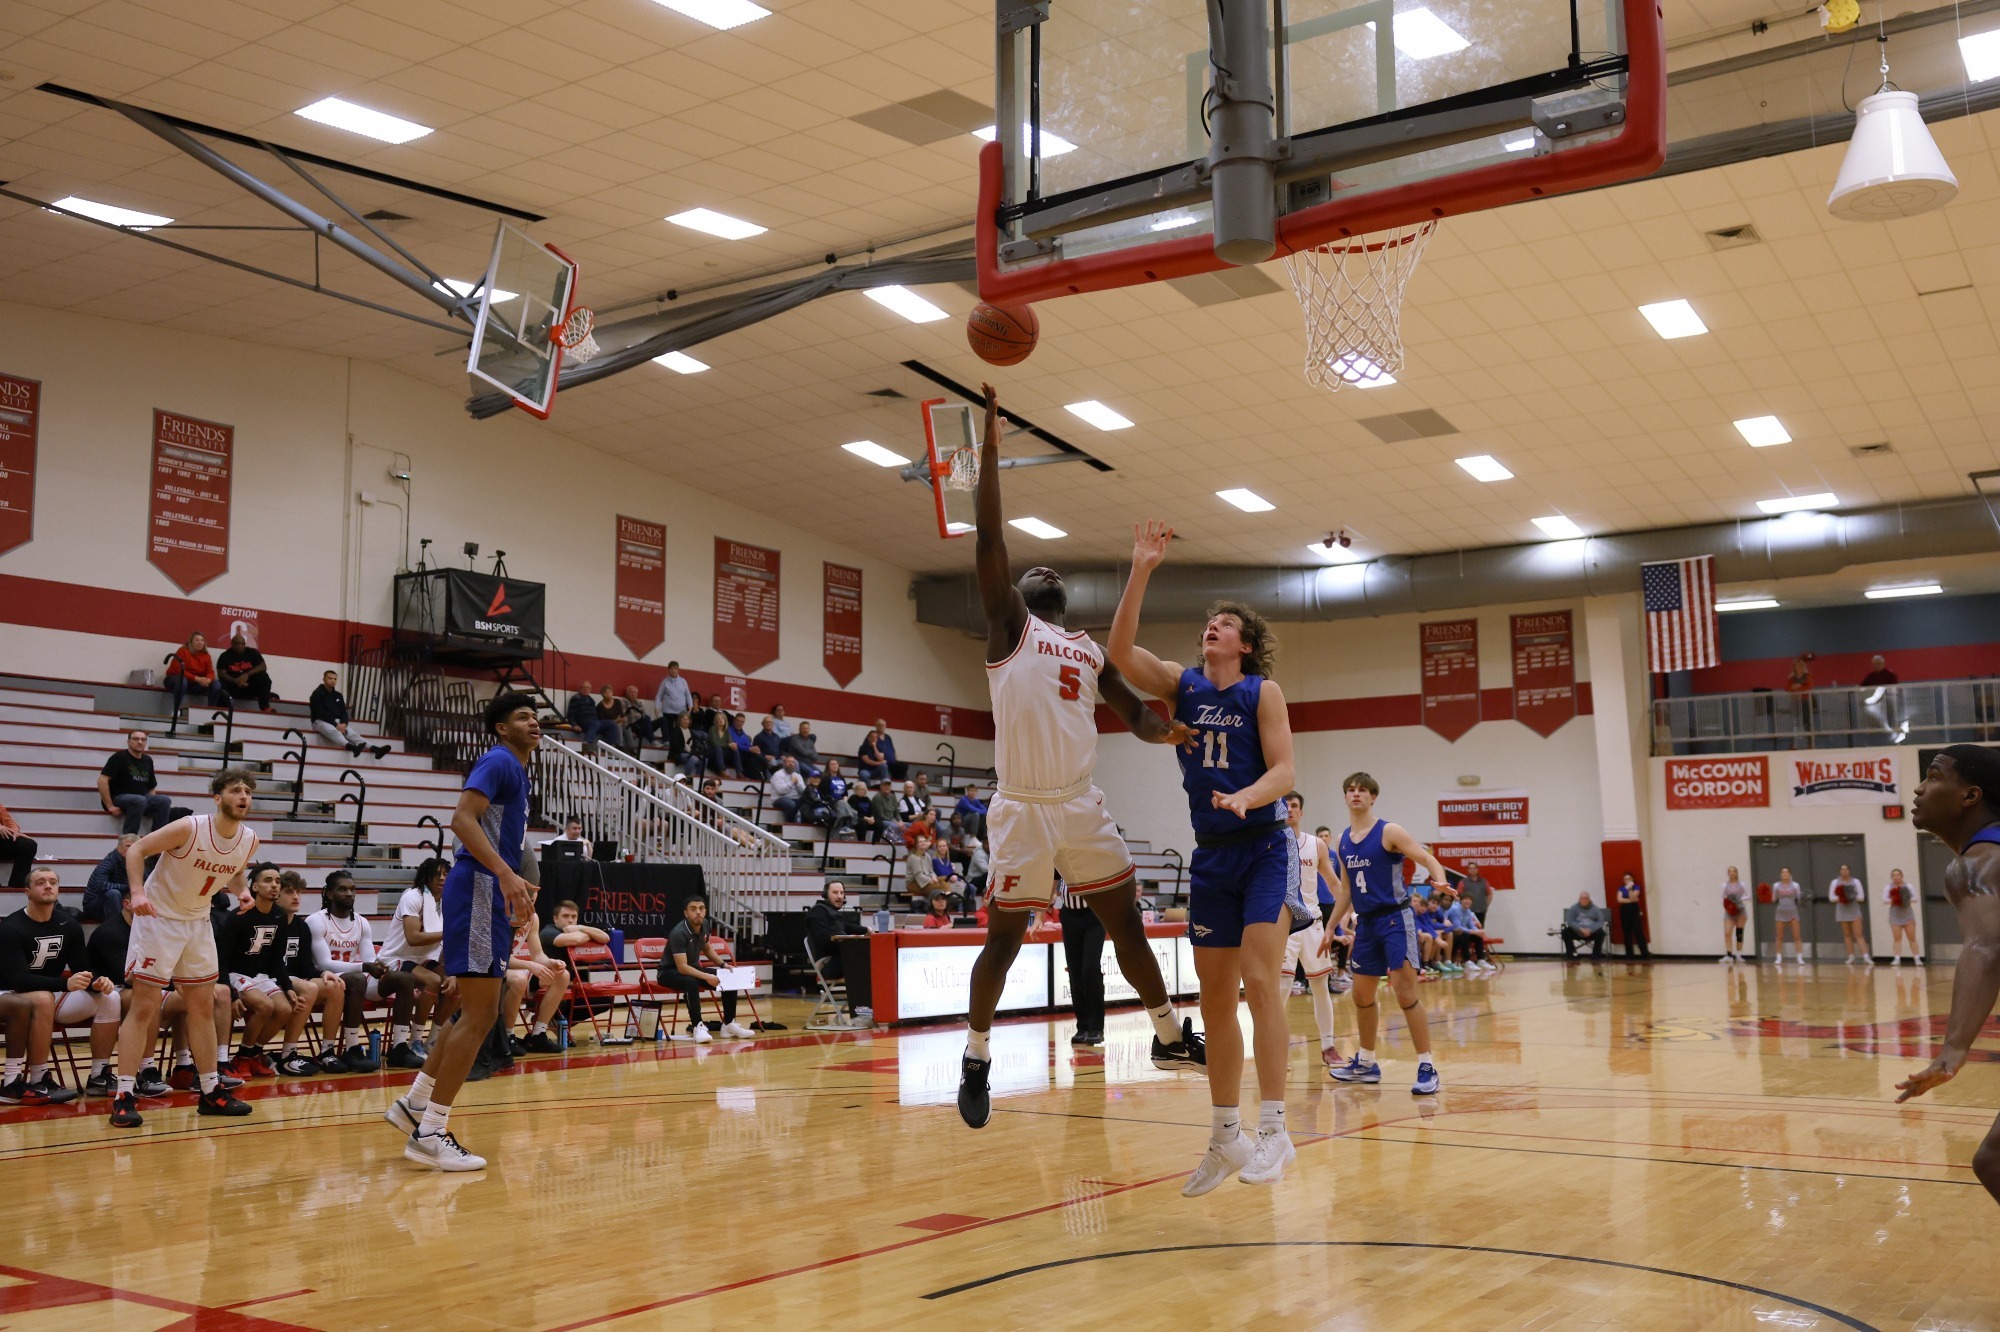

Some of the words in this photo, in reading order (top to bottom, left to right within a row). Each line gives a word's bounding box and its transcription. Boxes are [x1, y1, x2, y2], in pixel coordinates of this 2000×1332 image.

[162, 415, 226, 442] FRIENDS
[161, 431, 225, 451] UNIVERSITY
[165, 484, 195, 496] VOLLEYBALL
[163, 511, 193, 522] VOLLEYBALL
[621, 519, 662, 538] FRIENDS
[730, 544, 766, 561] FRIENDS
[827, 565, 859, 581] FRIENDS
[221, 606, 257, 619] SECTION
[1425, 624, 1472, 636] FRIENDS
[1517, 615, 1565, 628] FRIENDS
[1038, 641, 1097, 669] FALCONS
[724, 676, 746, 685] SECTION
[1059, 664, 1081, 701] 5
[731, 686, 740, 705] E
[940, 714, 948, 731] F
[1193, 704, 1243, 727] Tabor
[1203, 730, 1229, 768] 11
[1672, 761, 1762, 779] McCOWN
[1673, 779, 1762, 797] GORDON
[1442, 803, 1479, 813] MUNDS
[1482, 802, 1524, 811] ENERGY
[1498, 811, 1522, 820] INC.
[193, 859, 237, 874] FALCONS
[1346, 855, 1371, 869] Tabor
[199, 875, 216, 896] 1
[1001, 875, 1021, 892] F
[1355, 870, 1367, 894] 4
[585, 887, 666, 913] FRIENDS
[583, 912, 666, 926] UNIVERSITY
[245, 925, 278, 955] F
[330, 939, 358, 948] FALCONS
[28, 935, 64, 970] F
[142, 957, 157, 969] F
[903, 1002, 925, 1013] RESPECT
